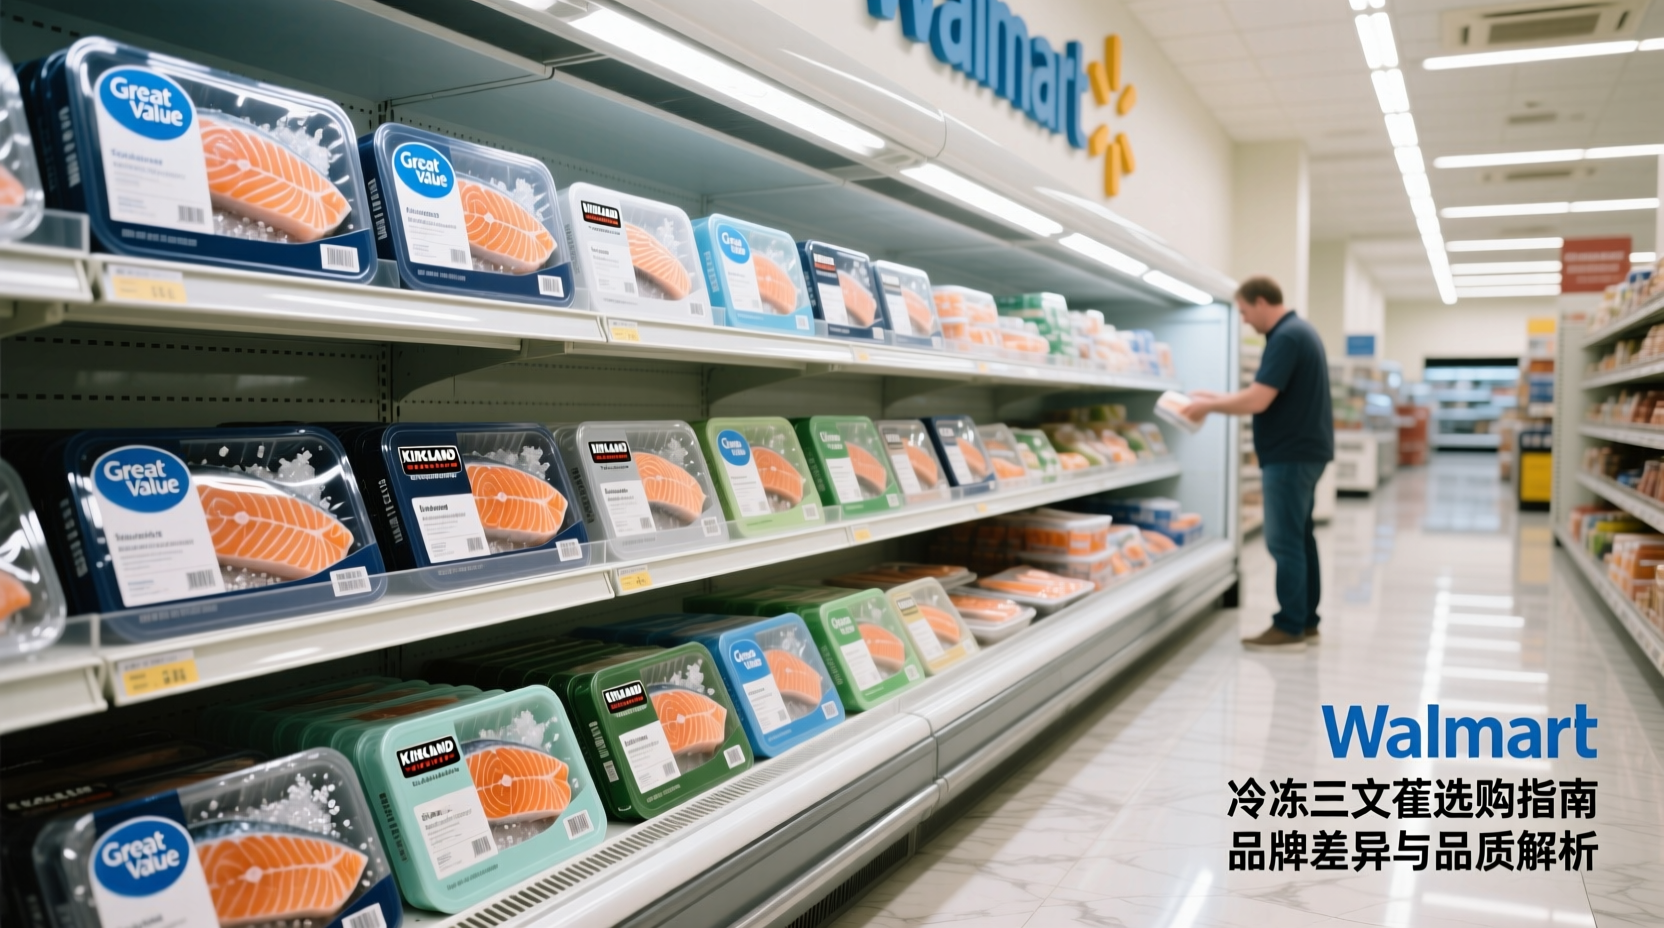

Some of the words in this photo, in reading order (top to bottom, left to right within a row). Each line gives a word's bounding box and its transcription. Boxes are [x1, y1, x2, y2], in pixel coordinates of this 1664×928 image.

[109, 76, 172, 108] Great
[129, 100, 184, 127] Value
[400, 151, 440, 173] Great
[103, 459, 167, 482] Great
[125, 477, 180, 497] Value
[101, 831, 167, 868] Great
